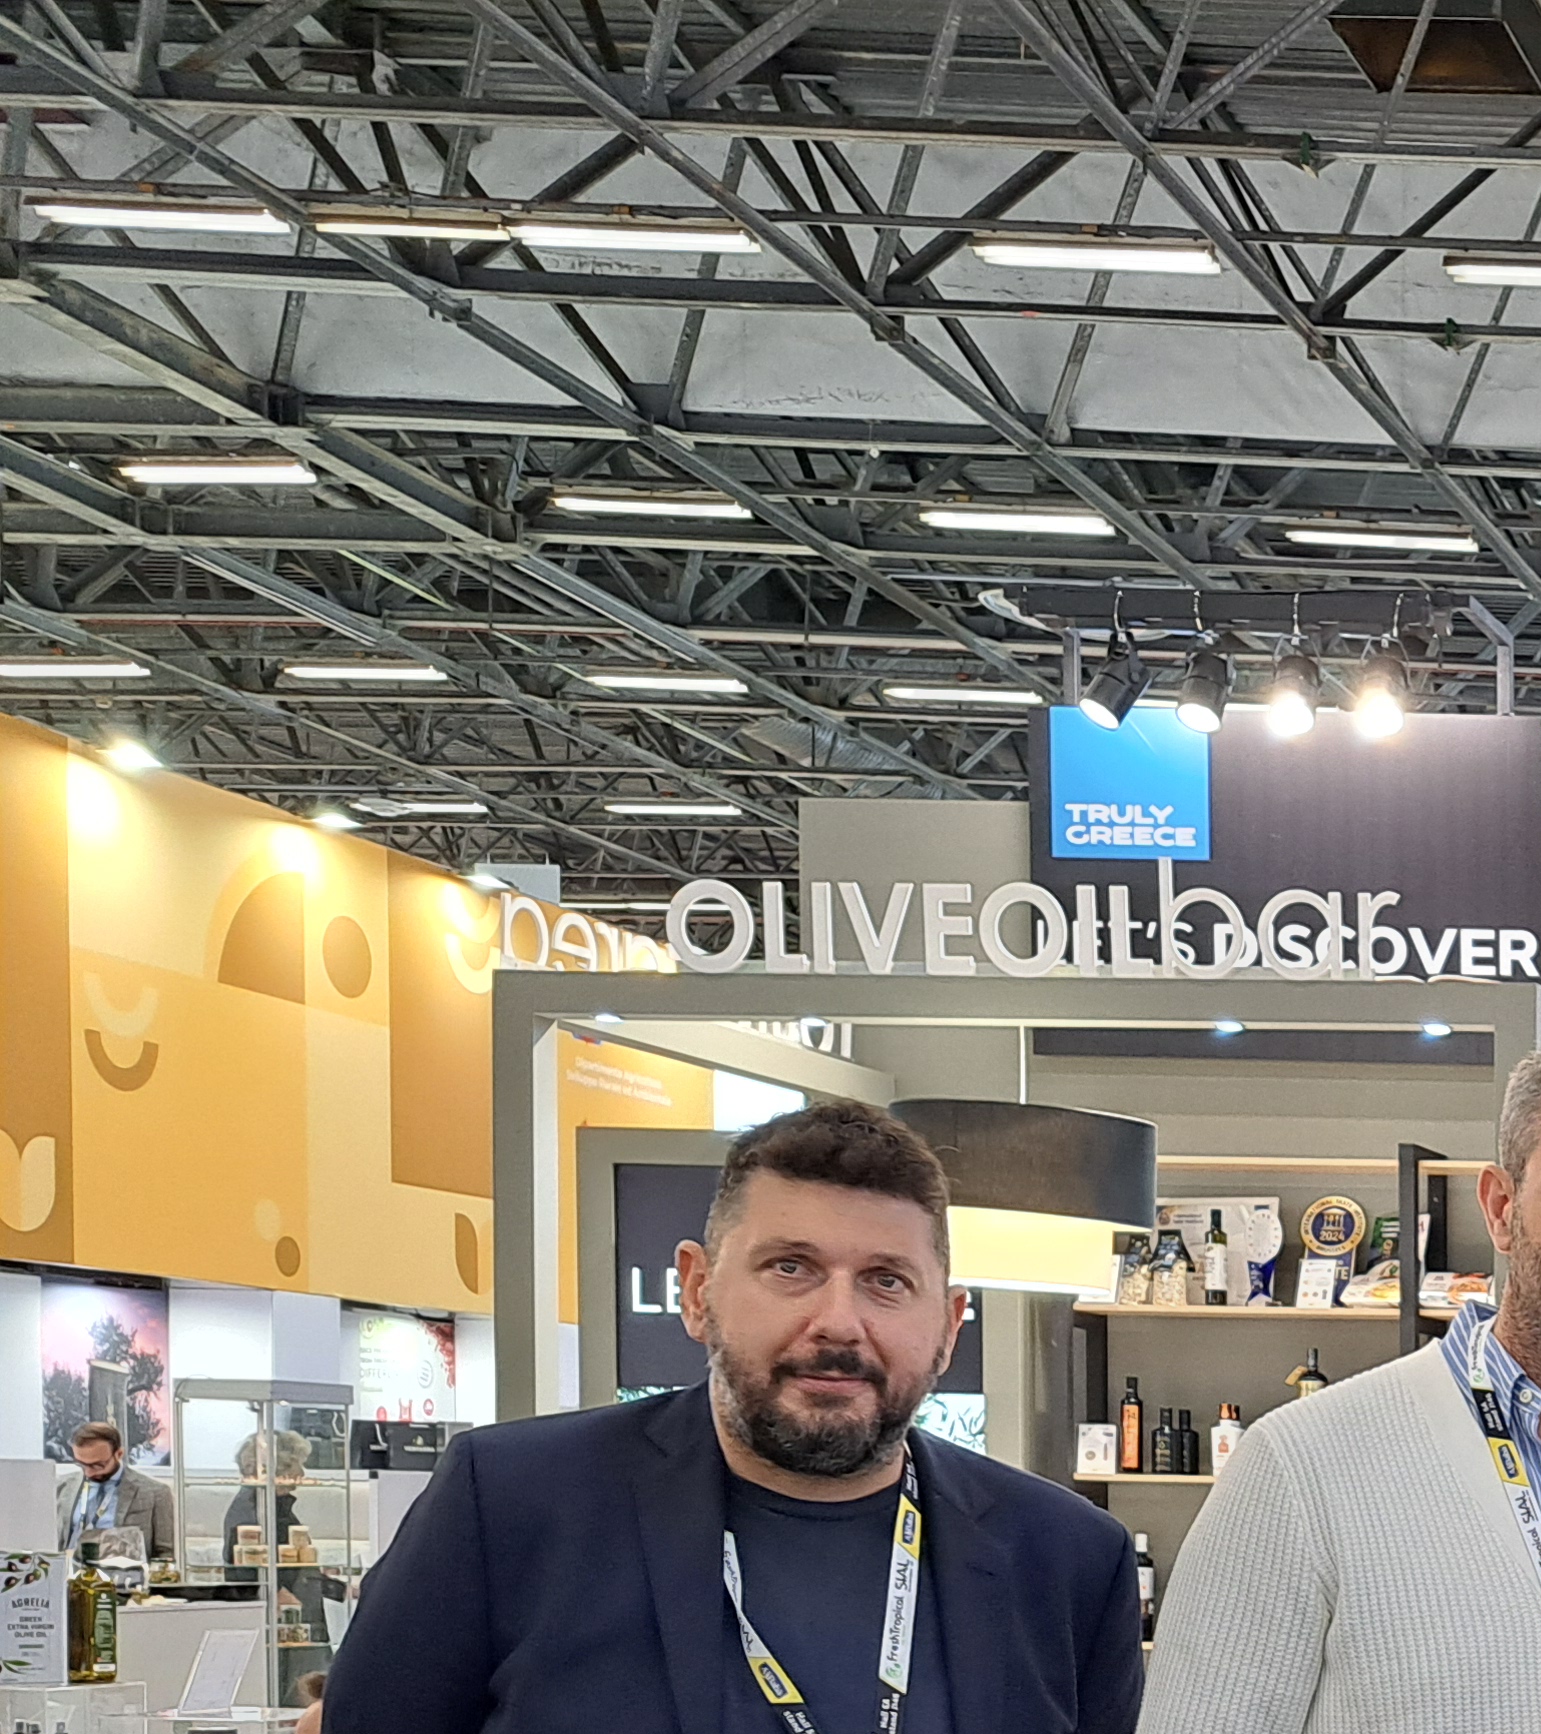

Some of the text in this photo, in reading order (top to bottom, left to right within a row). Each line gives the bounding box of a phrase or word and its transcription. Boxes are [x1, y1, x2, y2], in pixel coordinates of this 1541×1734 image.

[1065, 803, 1174, 825] TRULY
[1066, 825, 1196, 847] GREECE
[1319, 1230, 1345, 1241] 2024
[1514, 1490, 1534, 1524] SIAL
[887, 1559, 909, 1660] FreshTropical SIAL
